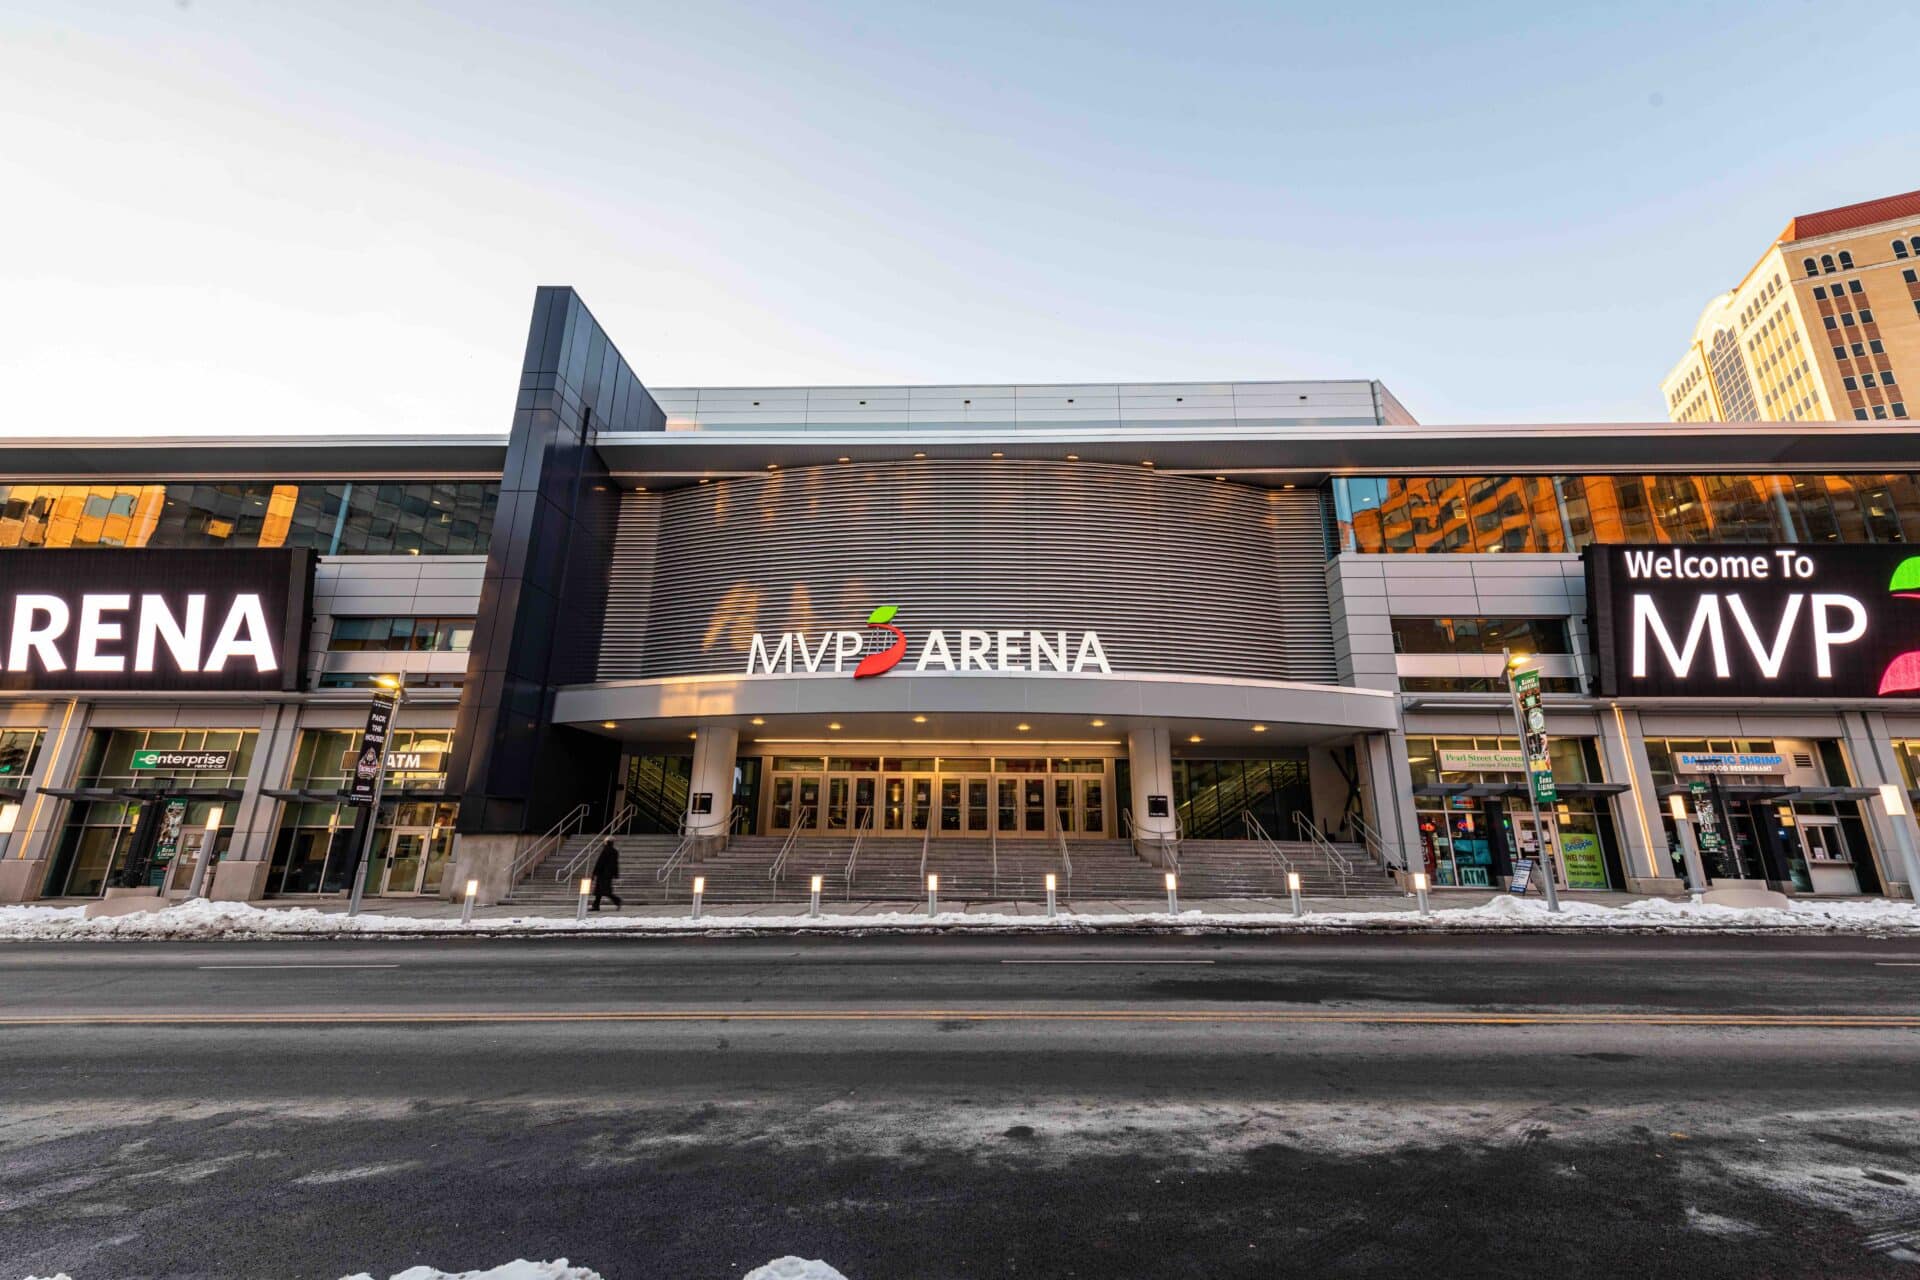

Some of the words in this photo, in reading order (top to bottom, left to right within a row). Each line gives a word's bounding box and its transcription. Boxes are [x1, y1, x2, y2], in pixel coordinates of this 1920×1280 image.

[1624, 549, 1768, 578] Welcome
[1775, 550, 1814, 578] To
[0, 594, 278, 672] RENA
[1631, 594, 1868, 678] MVP
[746, 631, 863, 674] MVP
[915, 629, 1113, 674] ARENA
[371, 714, 386, 723] PACK
[139, 753, 226, 767] enterprise
[387, 754, 420, 768] ATM
[1739, 755, 1782, 765] SHRIMP
[1463, 869, 1487, 885] ATM
